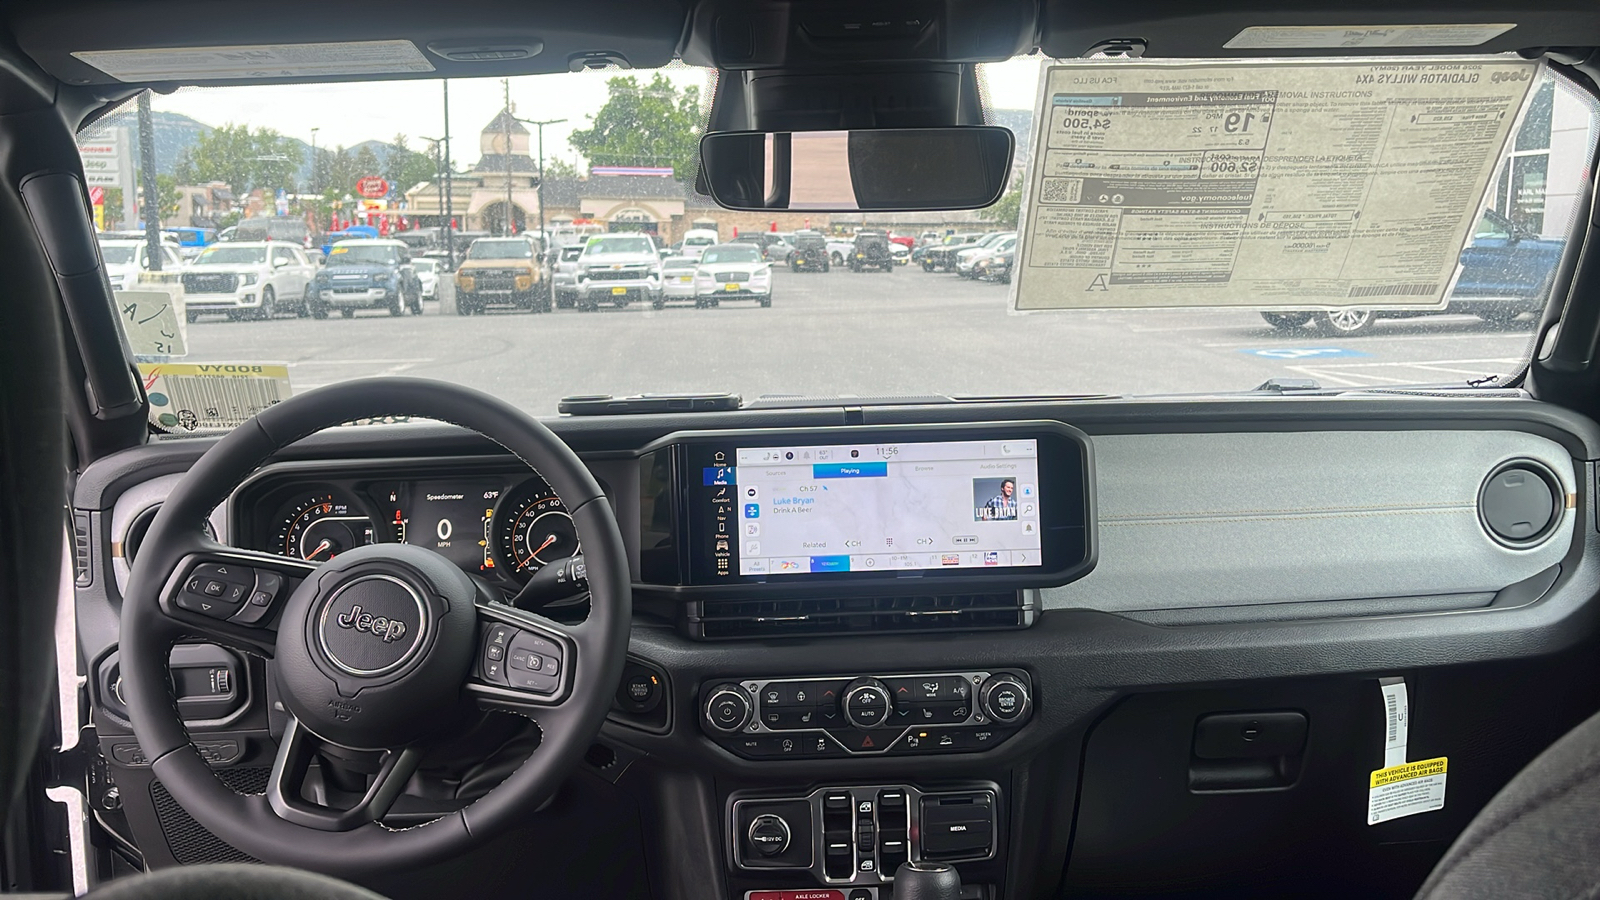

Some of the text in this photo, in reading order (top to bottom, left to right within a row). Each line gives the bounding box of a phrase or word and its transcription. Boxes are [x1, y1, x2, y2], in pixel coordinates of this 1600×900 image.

[1311, 90, 1373, 99] INSTRUCTIONS
[1264, 155, 1315, 163] DESPRENDER
[876, 447, 899, 455] 11:56
[390, 494, 397, 502] N
[793, 497, 815, 506] Bryan
[975, 507, 993, 518] LUKE
[437, 518, 453, 540] 0
[290, 535, 296, 543] 3
[211, 584, 222, 592] OK
[337, 604, 407, 644] Jeep
[1376, 771, 1388, 779] THIS
[1388, 767, 1410, 776] VEHICLE
[1417, 760, 1444, 770] EQUIPPED
[1389, 771, 1418, 782] ADVANCED
